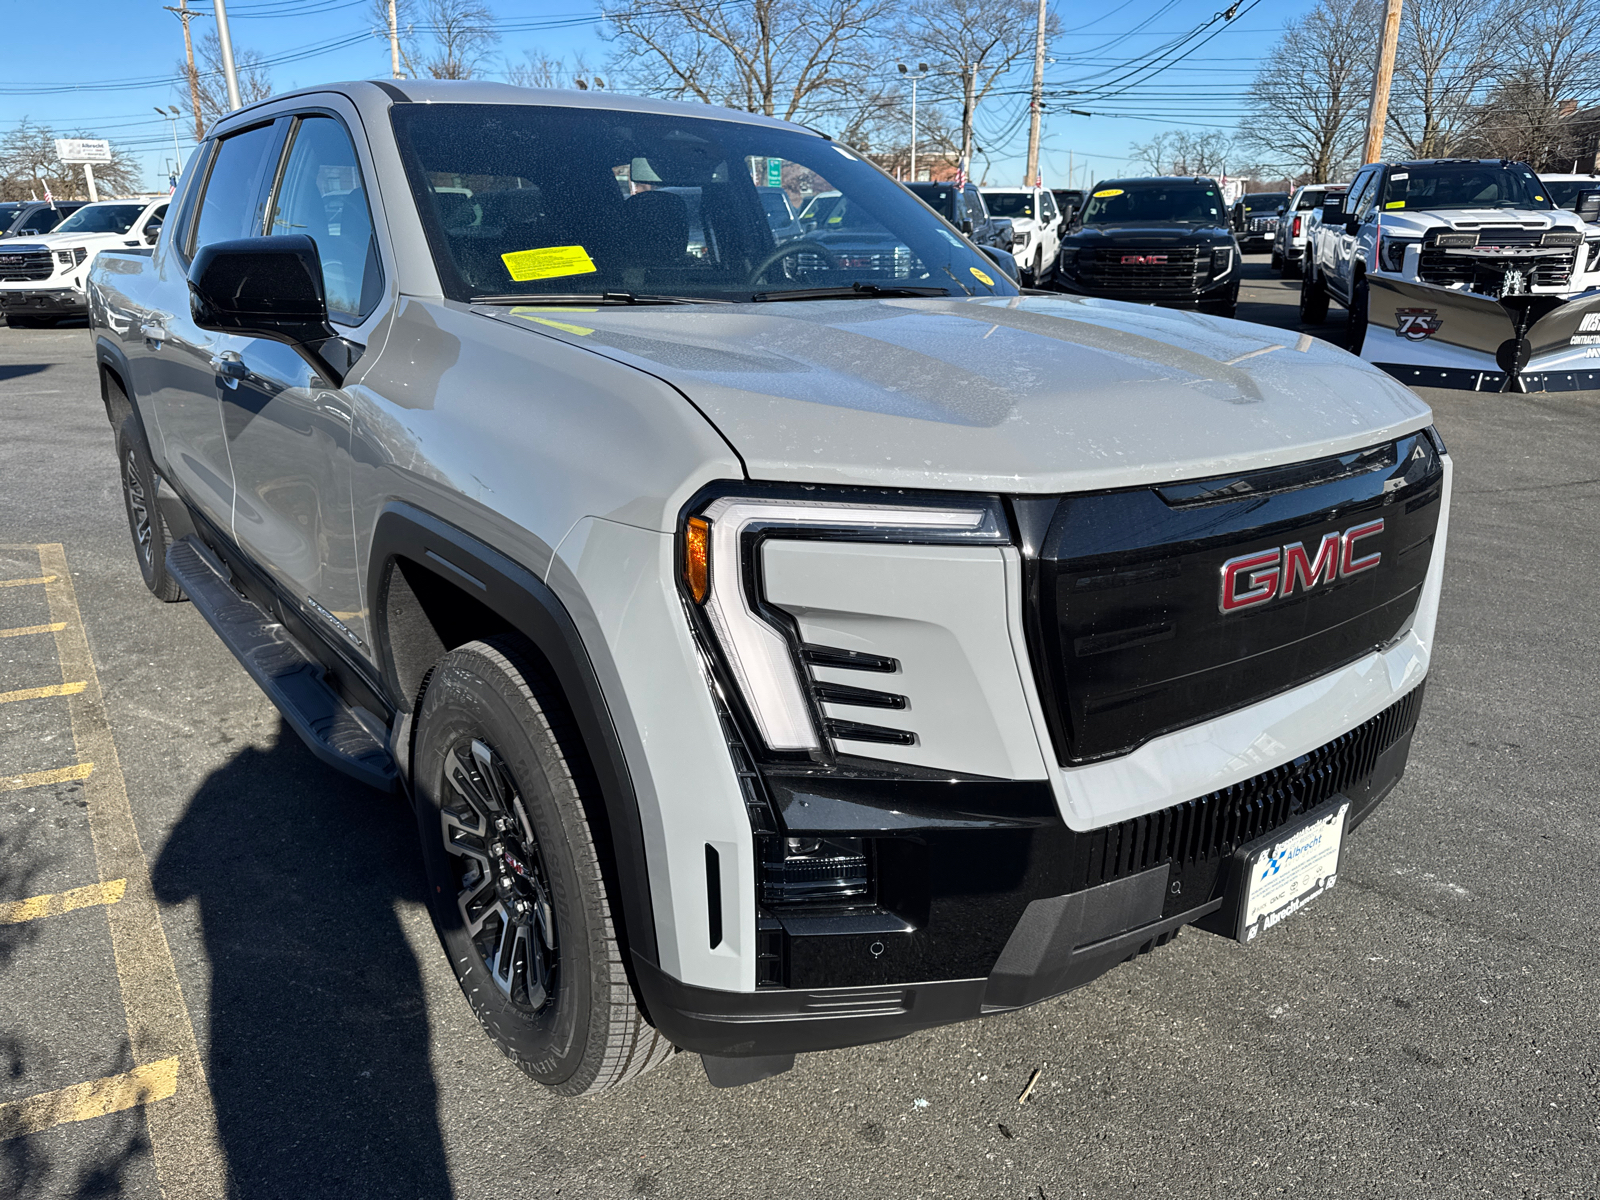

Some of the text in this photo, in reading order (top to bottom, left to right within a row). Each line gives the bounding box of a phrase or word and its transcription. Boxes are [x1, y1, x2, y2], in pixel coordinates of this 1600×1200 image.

[1121, 255, 1168, 264] GMC
[1399, 316, 1432, 338] 75
[1218, 517, 1385, 615] GMC
[515, 758, 573, 935] BRIDGESTONE
[1286, 834, 1322, 862] Albrecht
[1263, 898, 1300, 931] Albrecht
